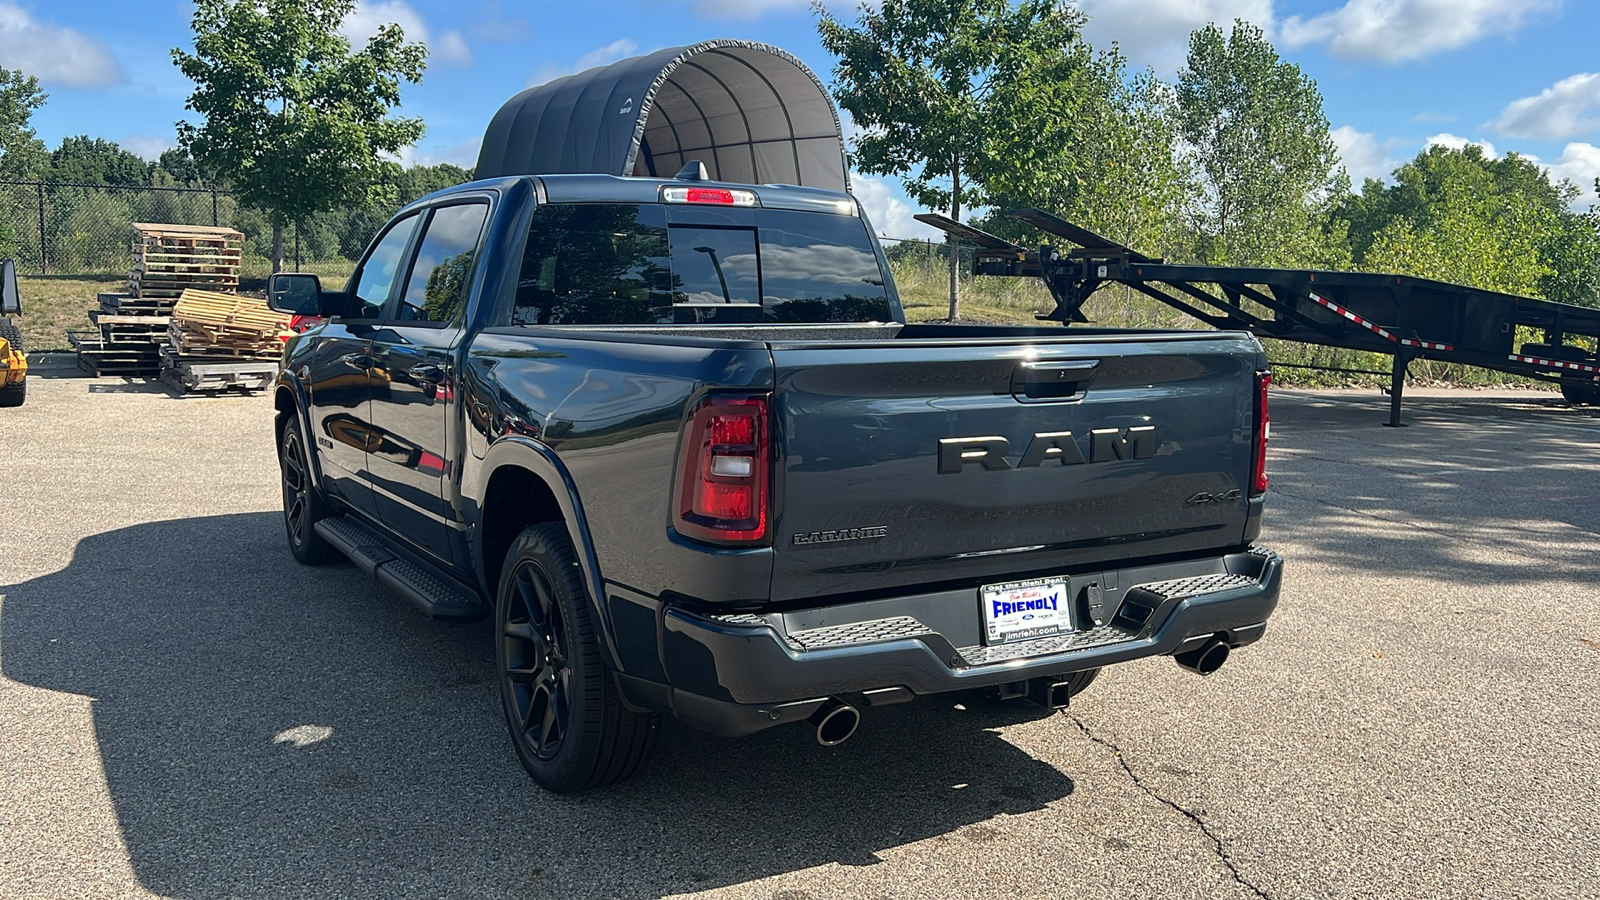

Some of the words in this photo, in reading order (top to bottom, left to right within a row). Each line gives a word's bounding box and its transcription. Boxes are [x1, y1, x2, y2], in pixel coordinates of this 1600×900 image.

[937, 425, 1156, 475] RAM
[793, 525, 888, 545] LARAMIE
[992, 592, 1058, 618] FRIENDLY
[1005, 626, 1058, 640] jimriehl.com
